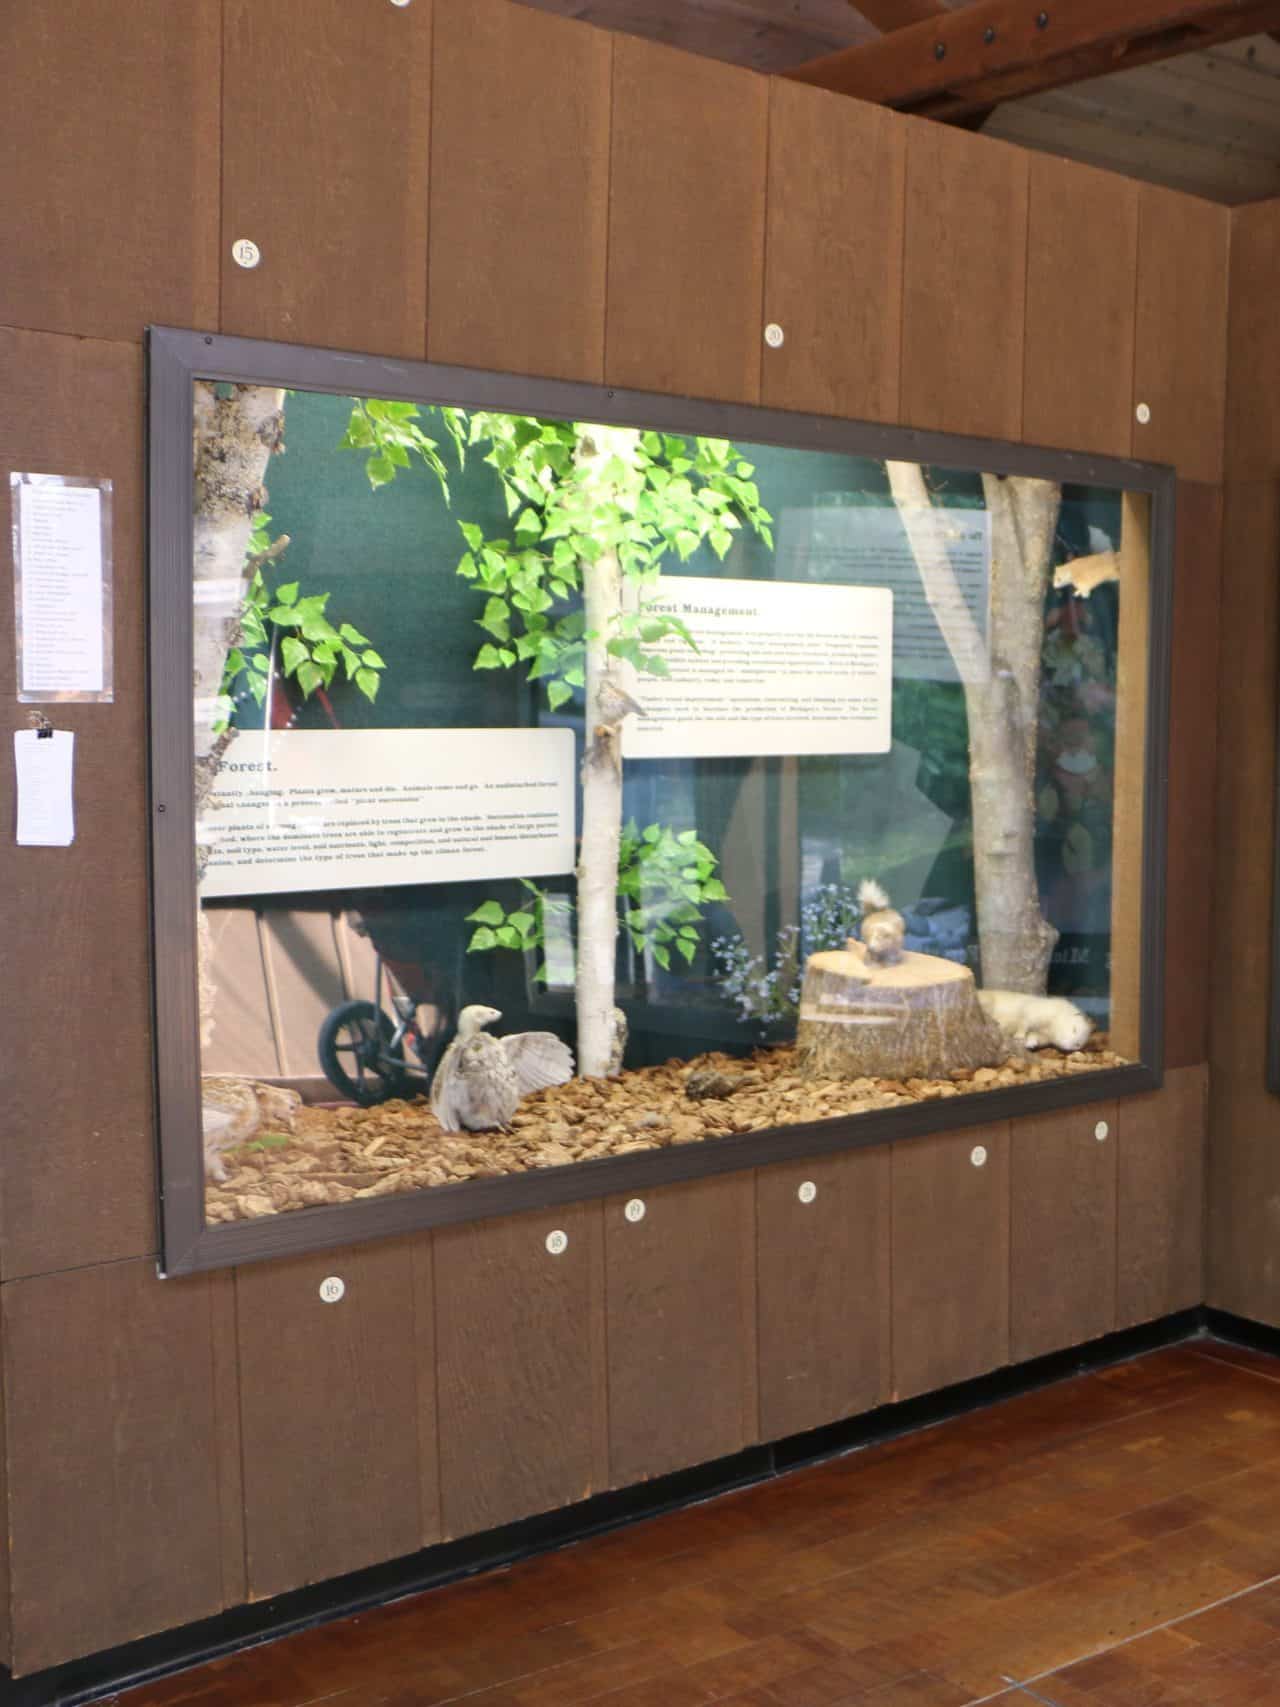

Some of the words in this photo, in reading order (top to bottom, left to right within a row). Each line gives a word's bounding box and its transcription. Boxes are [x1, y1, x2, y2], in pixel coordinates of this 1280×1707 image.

[239, 246, 254, 261] 15
[682, 603, 761, 617] Management.
[217, 760, 279, 773] Forest.
